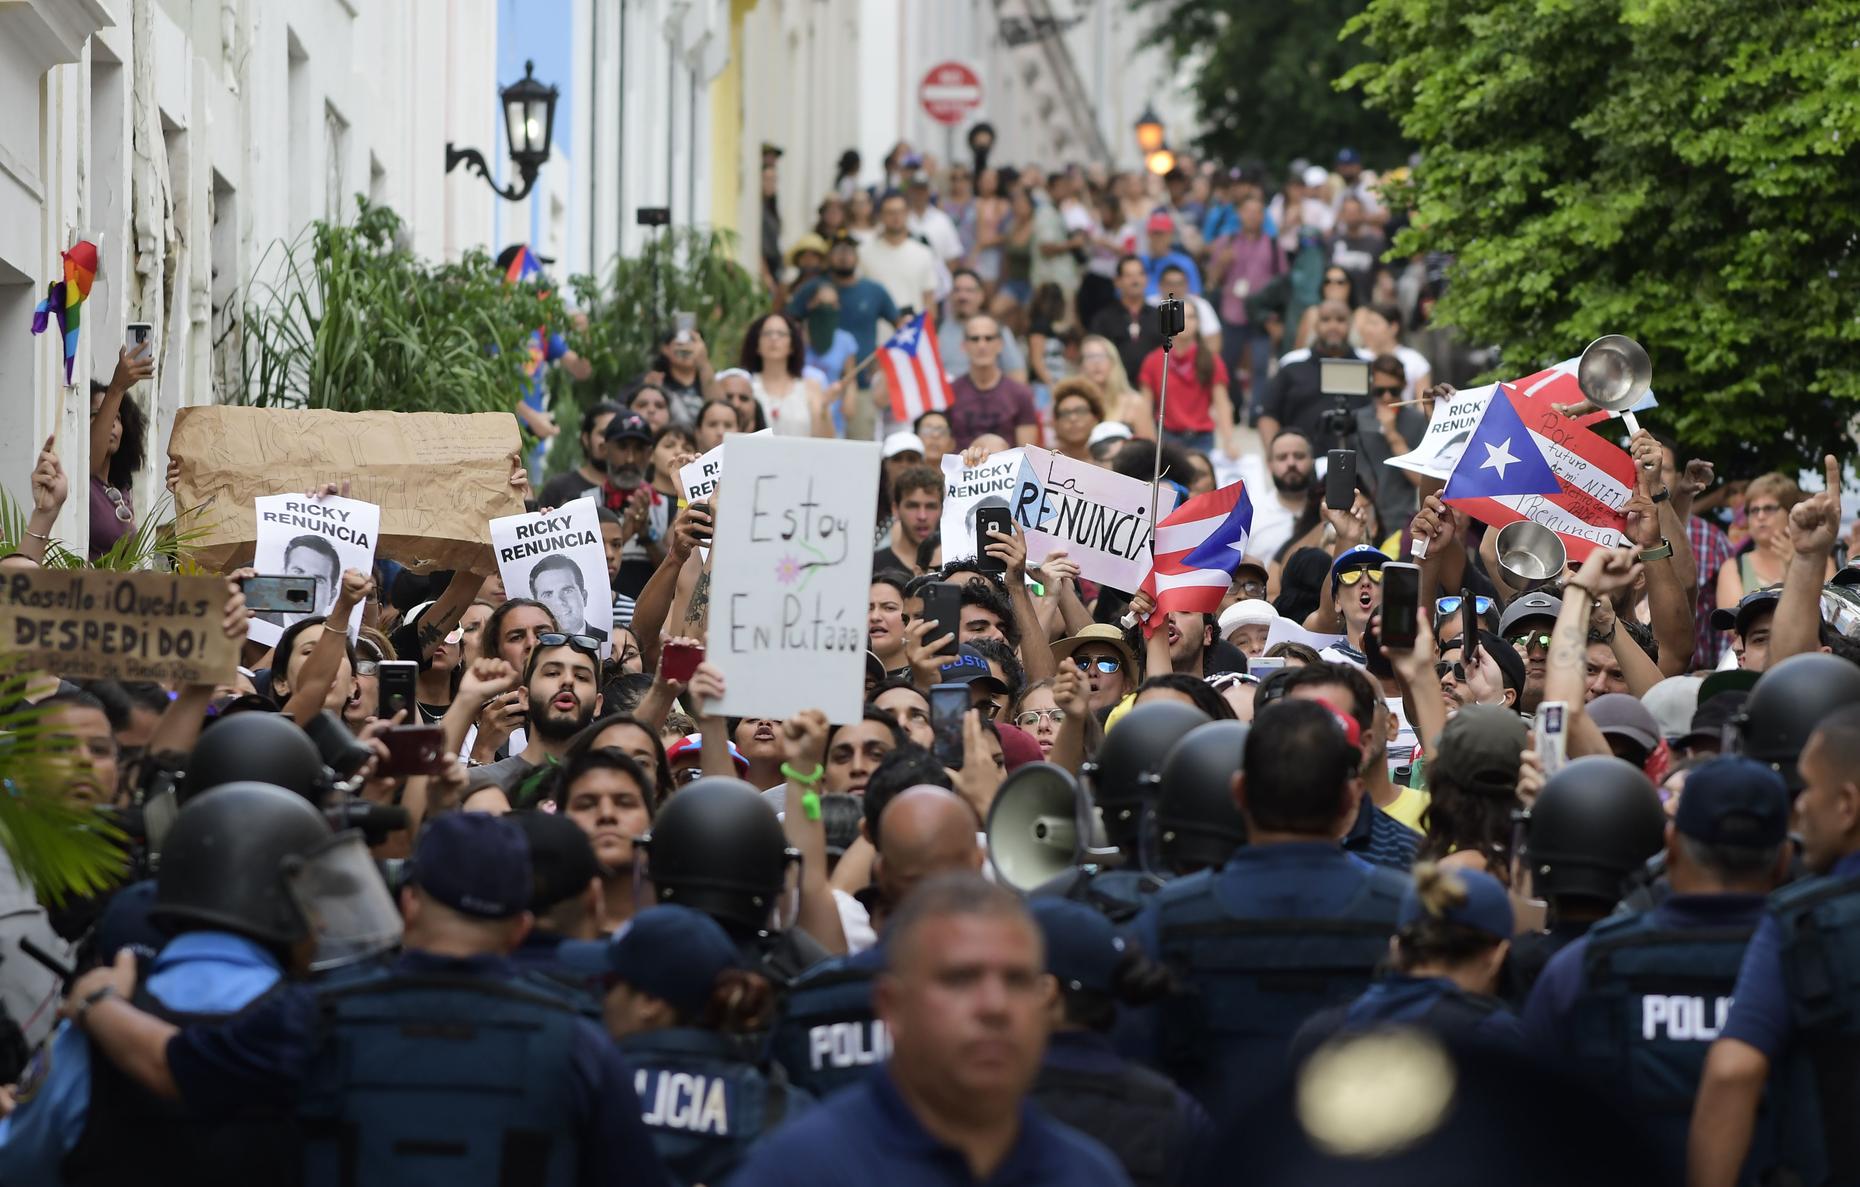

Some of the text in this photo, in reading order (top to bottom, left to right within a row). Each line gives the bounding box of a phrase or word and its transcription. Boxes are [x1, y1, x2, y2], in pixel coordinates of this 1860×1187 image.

[1431, 416, 1478, 433] RENUN
[1449, 400, 1486, 417] RICK
[948, 477, 1016, 498] RENUNC
[962, 462, 1014, 482] RICKY
[1047, 460, 1084, 494] La
[286, 502, 351, 522] RICKY
[515, 515, 572, 540] RICKY
[751, 475, 849, 570] Estoy
[263, 511, 369, 549] RENUNCIA
[500, 530, 598, 563] RENUNCIA
[1643, 995, 1735, 1040] POLI
[809, 1019, 895, 1071] POLI
[634, 1068, 728, 1134] LICIA
